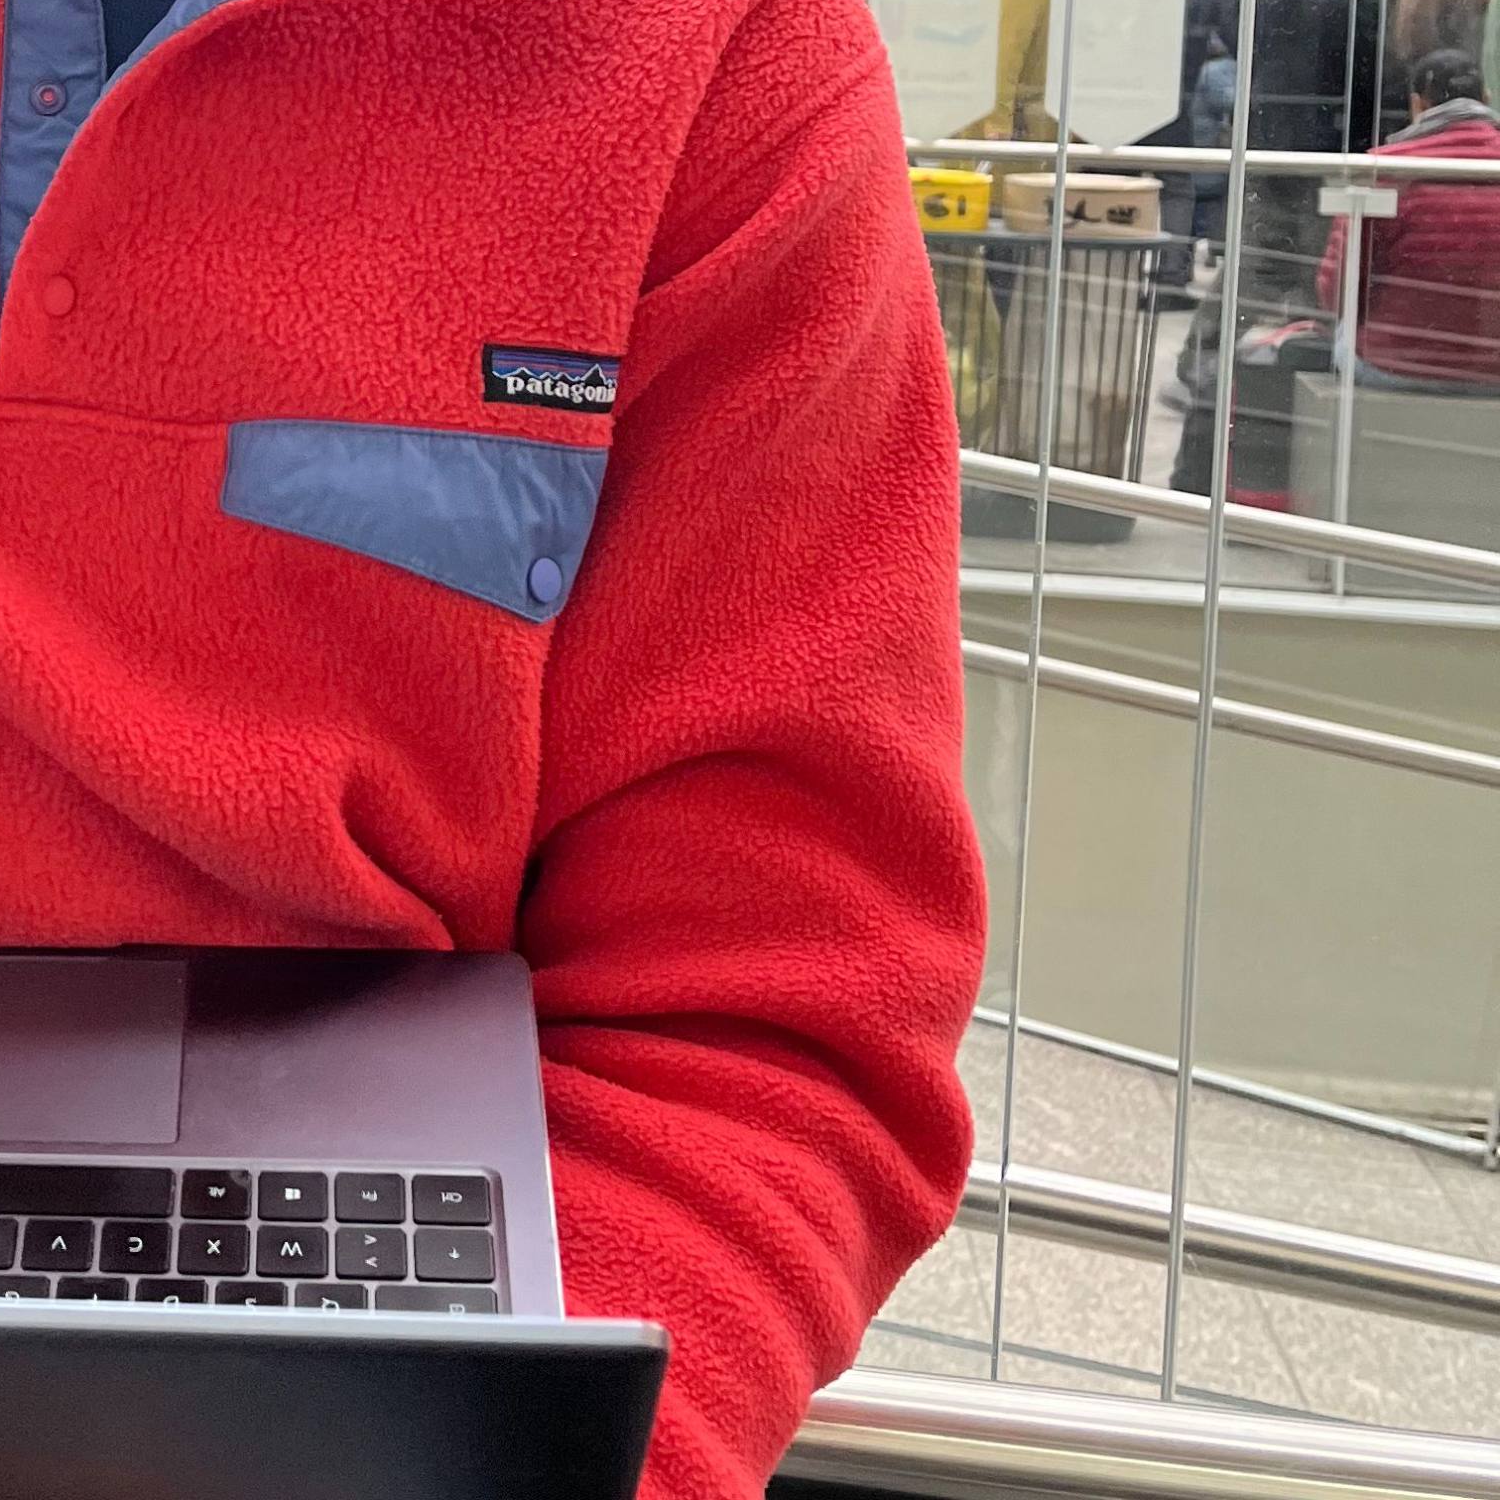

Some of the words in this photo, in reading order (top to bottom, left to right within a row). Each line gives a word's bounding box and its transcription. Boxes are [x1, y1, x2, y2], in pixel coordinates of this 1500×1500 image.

[506, 376, 616, 404] patagoni
[208, 1186, 226, 1198] Alt
[441, 1191, 463, 1203] Ctrl
[51, 1235, 67, 1251] V
[128, 1236, 144, 1253] C
[206, 1238, 221, 1254] X
[280, 1241, 303, 1256] W
